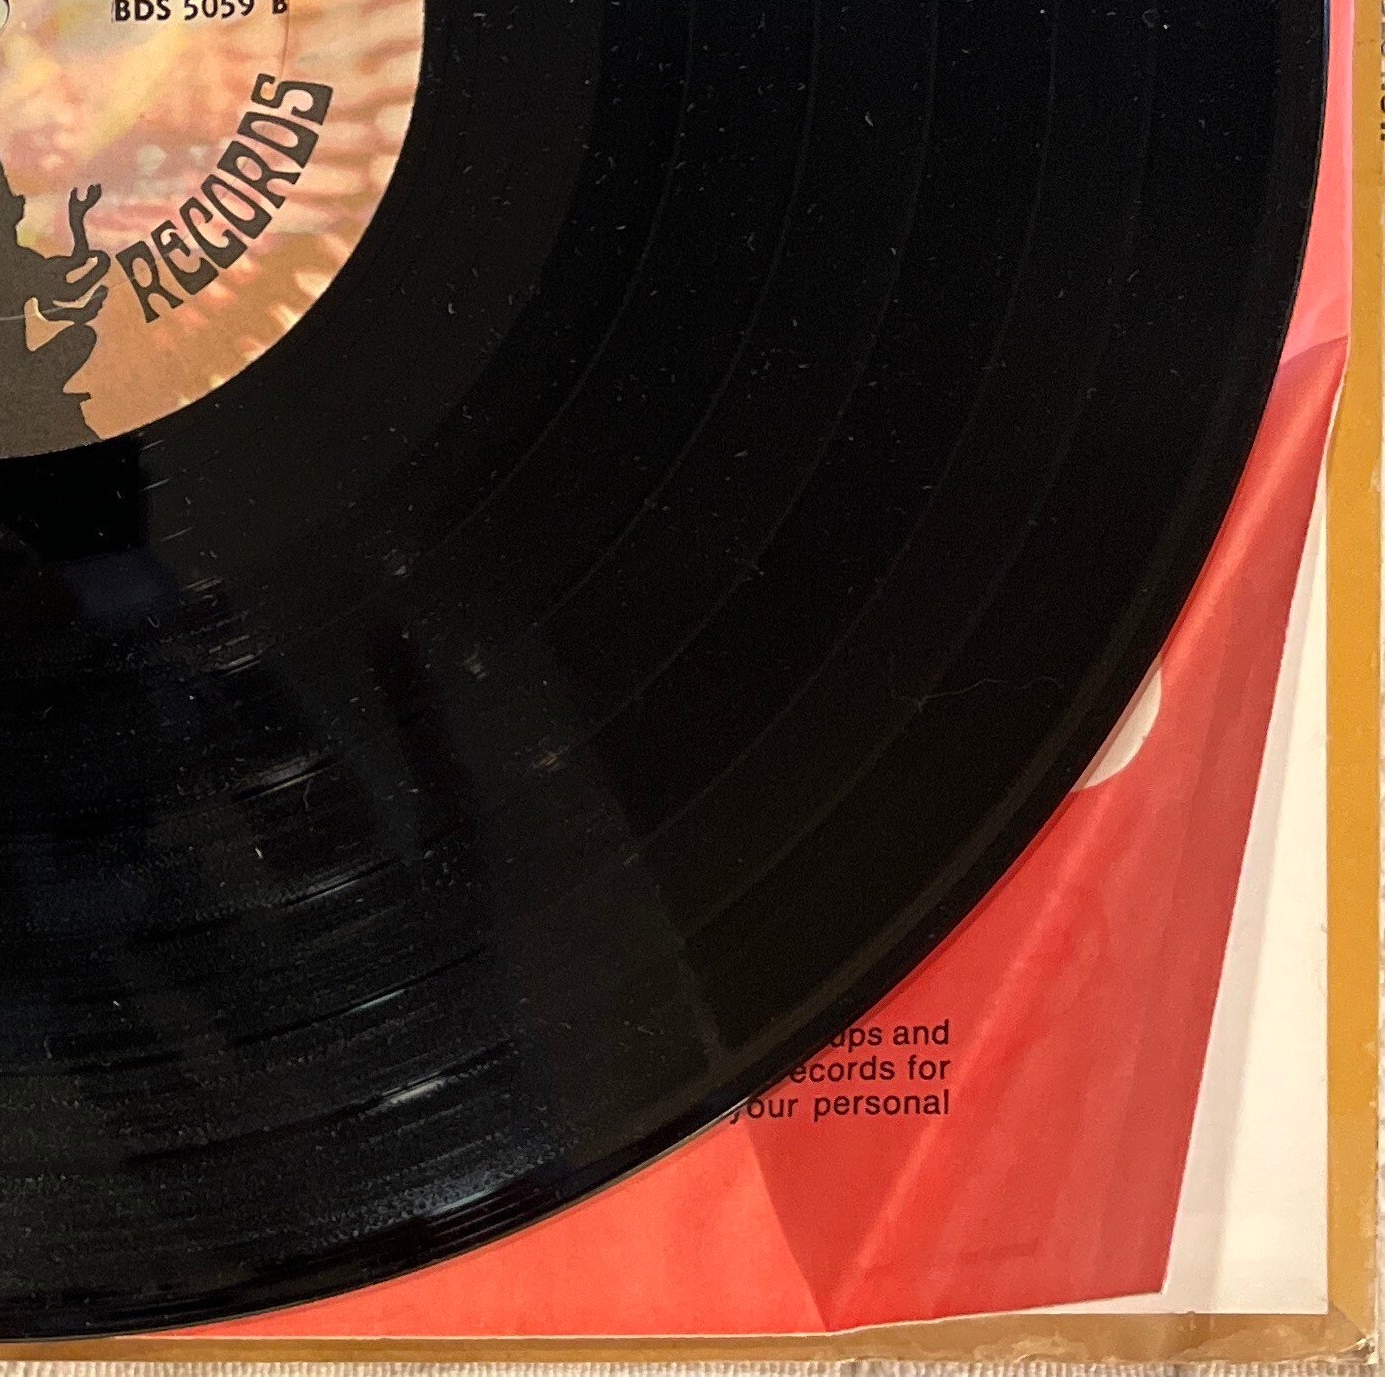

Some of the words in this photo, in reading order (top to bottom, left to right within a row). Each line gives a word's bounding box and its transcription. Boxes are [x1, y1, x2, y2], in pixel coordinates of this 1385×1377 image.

[115, 73, 334, 324] RECORDS
[892, 1019, 950, 1046] and
[907, 1054, 952, 1080] for
[729, 1097, 799, 1125] our
[813, 1089, 950, 1123] personal
